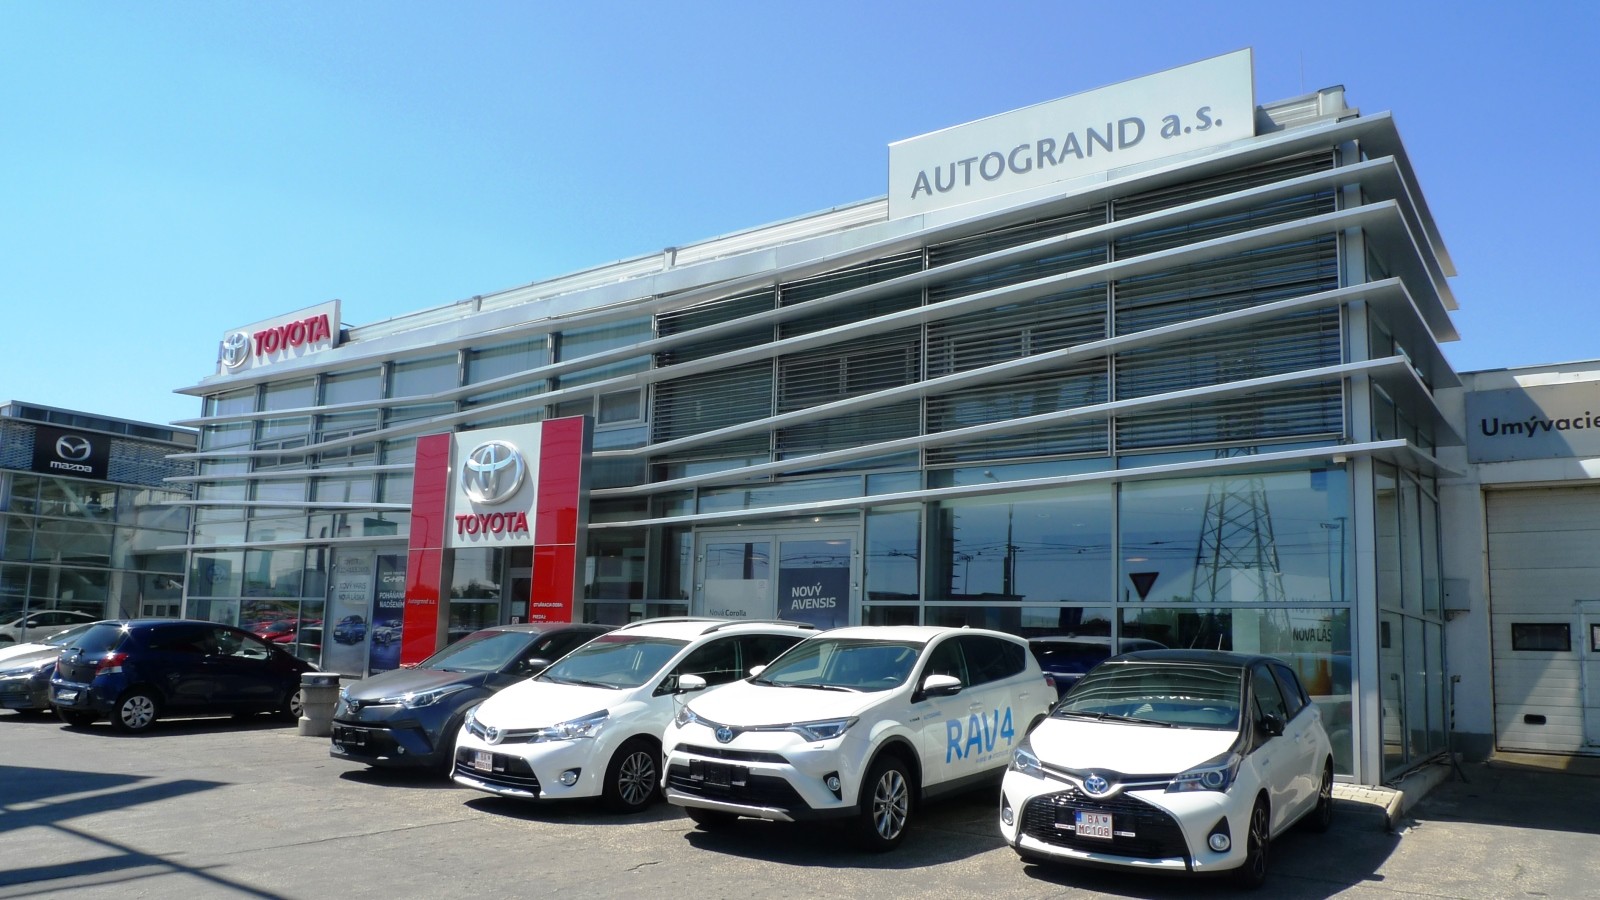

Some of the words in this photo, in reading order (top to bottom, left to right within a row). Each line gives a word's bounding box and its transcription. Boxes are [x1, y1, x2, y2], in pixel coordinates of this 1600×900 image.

[911, 117, 1145, 200] AUTOGRAND
[1160, 106, 1223, 139] a.s.
[253, 314, 330, 357] TOYOTA
[455, 511, 529, 535] TOYOTA
[791, 582, 822, 597] NOVÝ
[791, 597, 836, 610] AVENSIS
[709, 608, 724, 616] Nová
[725, 609, 747, 617] Corolla
[946, 706, 1014, 764] RAV4
[1087, 815, 1099, 824] BA
[1078, 825, 1109, 836] MC108
